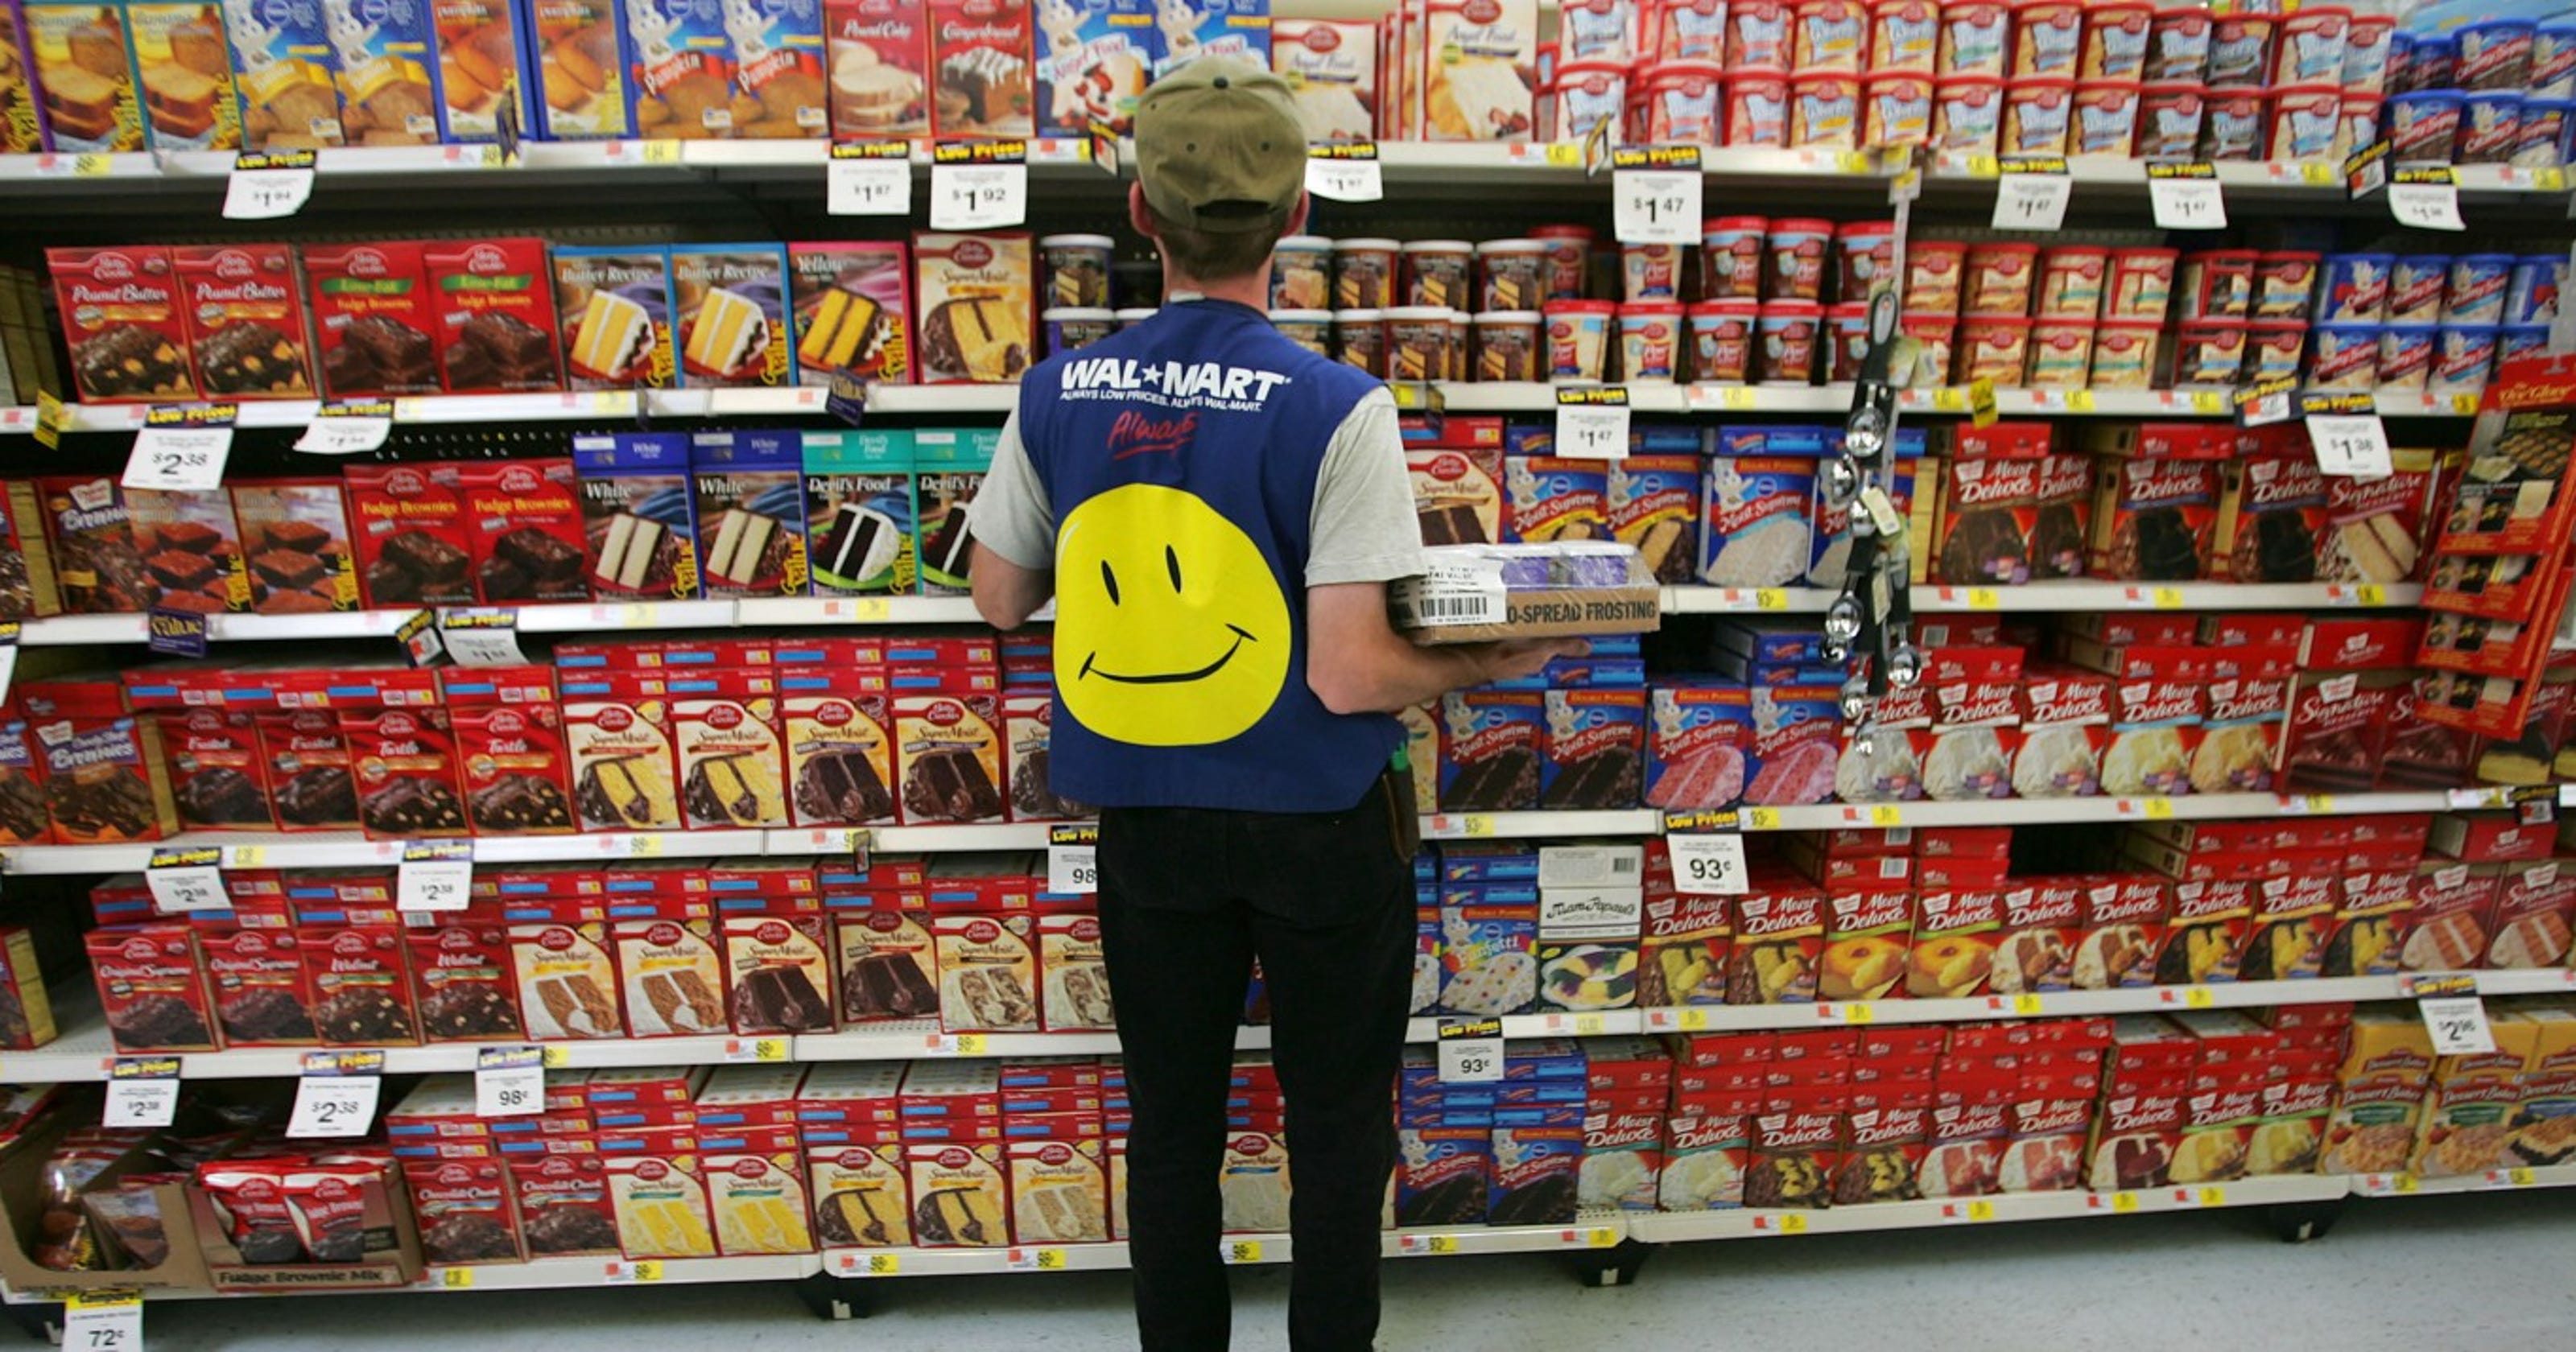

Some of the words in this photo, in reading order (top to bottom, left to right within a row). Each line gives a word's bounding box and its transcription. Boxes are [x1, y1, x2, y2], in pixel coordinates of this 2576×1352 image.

[798, 256, 844, 273] Yellow
[72, 283, 122, 300] Peanut
[124, 285, 169, 301] Butter
[196, 283, 242, 299] Peanut
[243, 285, 287, 300] Butter
[1060, 390, 1098, 401] ALWAYS
[1100, 389, 1124, 401] LOW
[586, 477, 633, 498] White
[700, 477, 745, 496] White
[808, 477, 851, 493] Devil's
[857, 477, 892, 493] Food
[919, 476, 964, 491] Devil's
[1959, 476, 2037, 502] Deluxe
[361, 500, 396, 515] Fudge
[399, 500, 457, 515] Brownies
[474, 497, 510, 513] Fudge
[514, 497, 572, 513] Brownies
[1586, 600, 1657, 621] FROSTING
[1945, 701, 2016, 723] Deluxe
[2029, 699, 2104, 722] Deluxe
[378, 740, 422, 756] Turtle
[489, 738, 528, 755] Turtle
[1653, 913, 1725, 934] Deluxe
[1746, 913, 1818, 934] Deluxe
[1835, 910, 1907, 933] Deluxe
[1925, 909, 1996, 932] Deluxe
[1586, 1127, 1658, 1148] Deluxe
[1762, 1127, 1835, 1147] Deluxe
[218, 1271, 275, 1288] Fudge
[279, 1269, 345, 1286] Brownie
[349, 1268, 384, 1284] Mix
